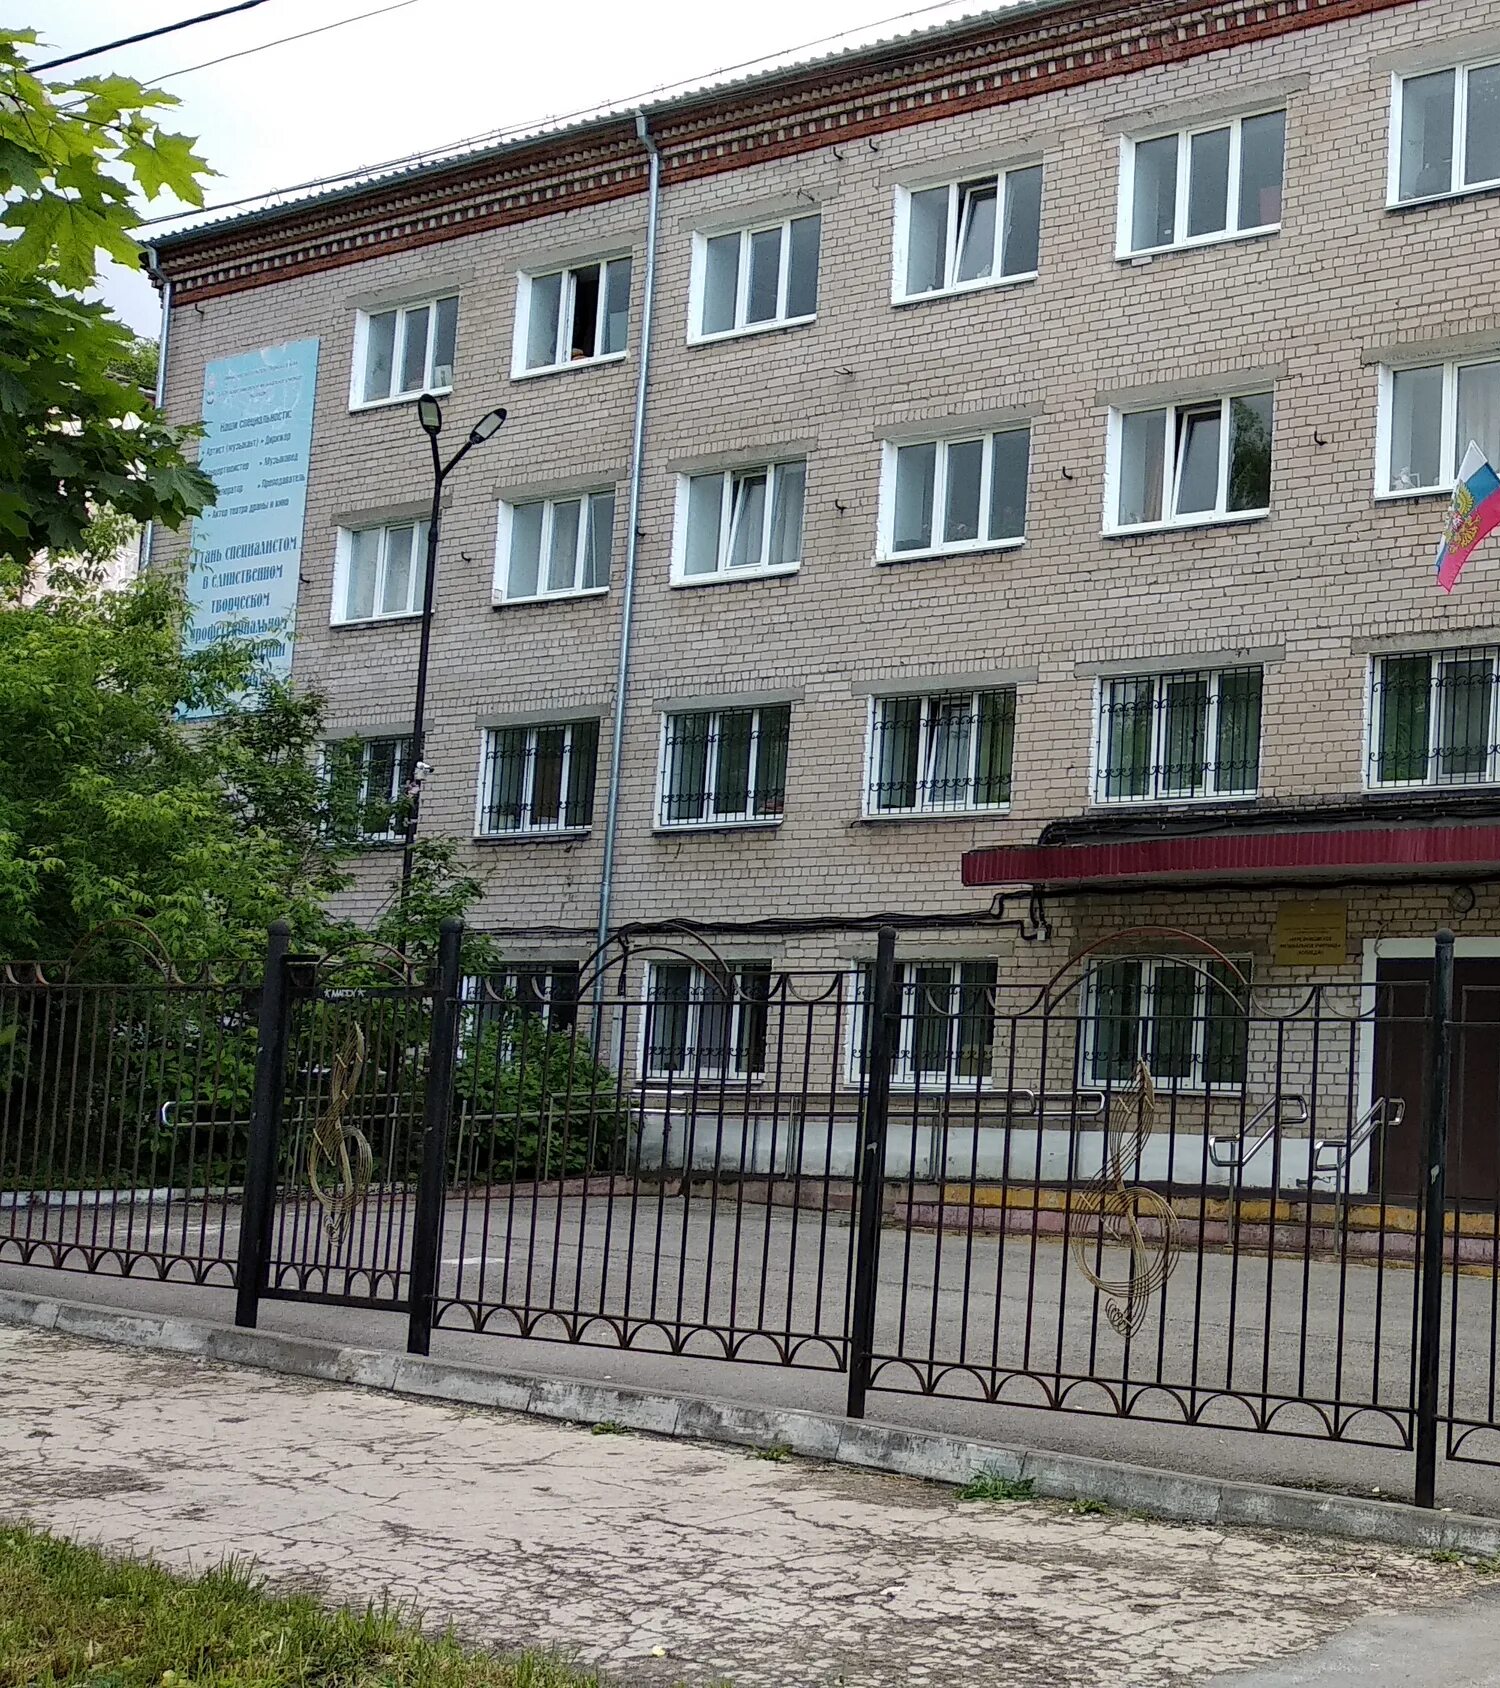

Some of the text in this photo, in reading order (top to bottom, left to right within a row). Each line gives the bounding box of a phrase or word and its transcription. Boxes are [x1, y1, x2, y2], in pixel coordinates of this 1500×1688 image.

[220, 422, 238, 432] Наши
[225, 536, 297, 560] специалистом
[202, 564, 283, 589] в единственном
[211, 592, 270, 614] творческом
